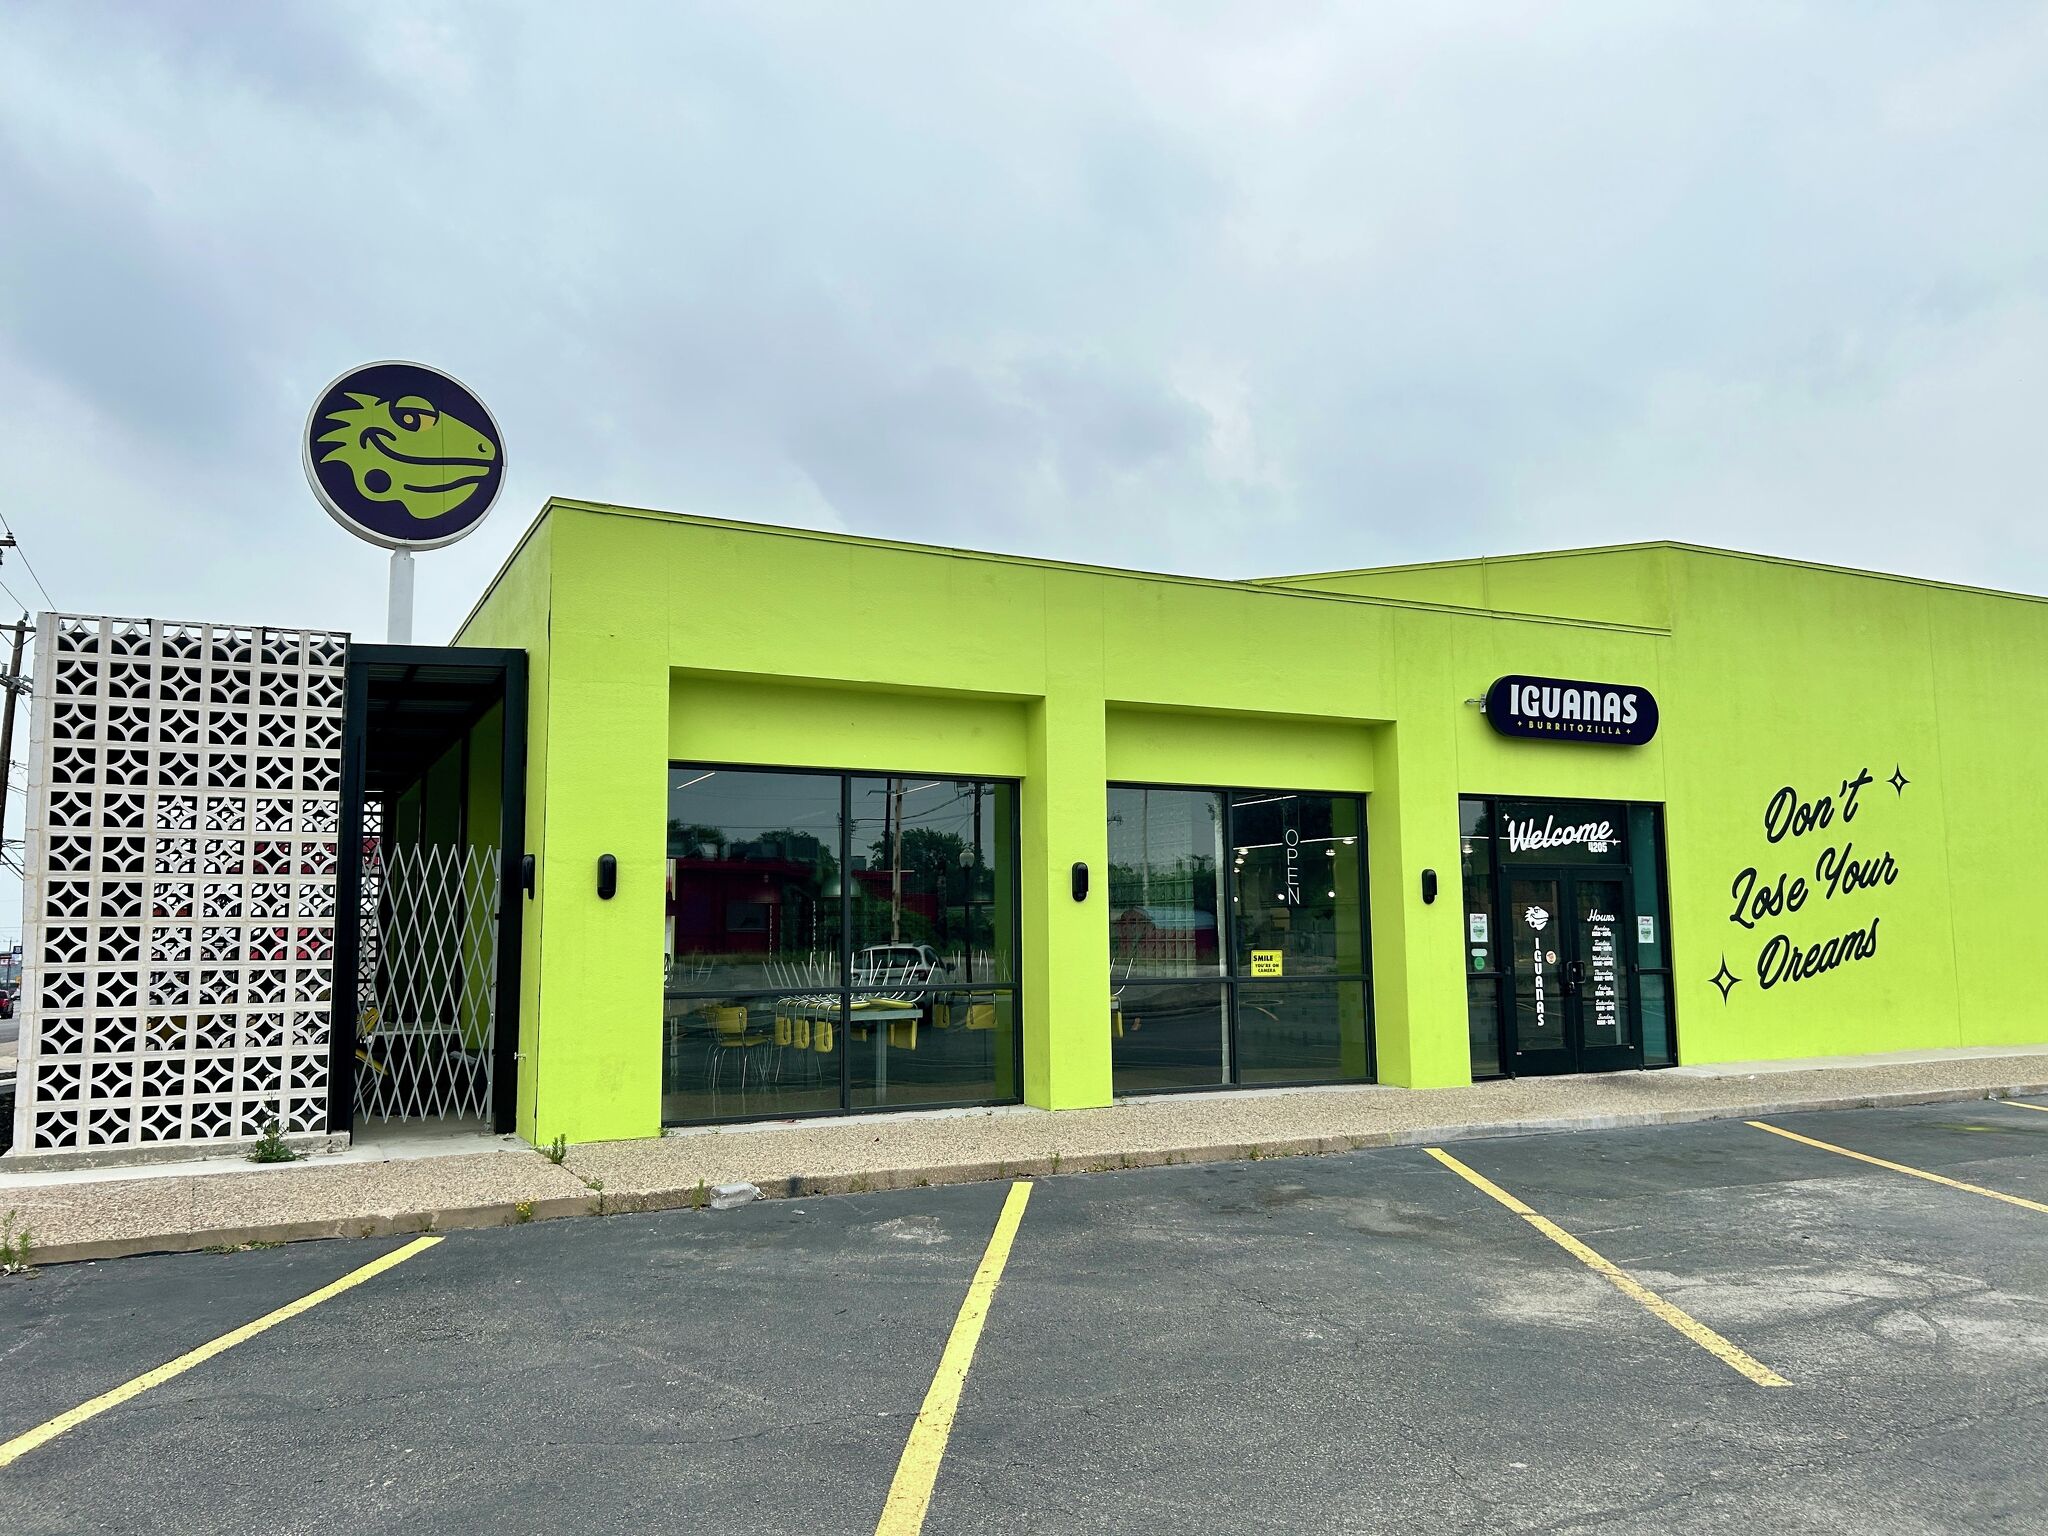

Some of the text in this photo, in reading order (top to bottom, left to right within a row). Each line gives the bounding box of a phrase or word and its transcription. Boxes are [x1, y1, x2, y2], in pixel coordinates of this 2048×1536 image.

[1510, 684, 1638, 725] IGUANAS
[1528, 720, 1621, 735] BURRITOZILLA
[1508, 814, 1613, 853] Welcome
[1765, 767, 1873, 843] Don't
[1285, 829, 1300, 905] OPEN
[1587, 841, 1608, 853] 4205
[1729, 842, 1899, 929] Lose Your
[1587, 909, 1615, 921] Hours
[1534, 937, 1545, 1026] IGUANAS
[1757, 917, 1879, 990] Dreams
